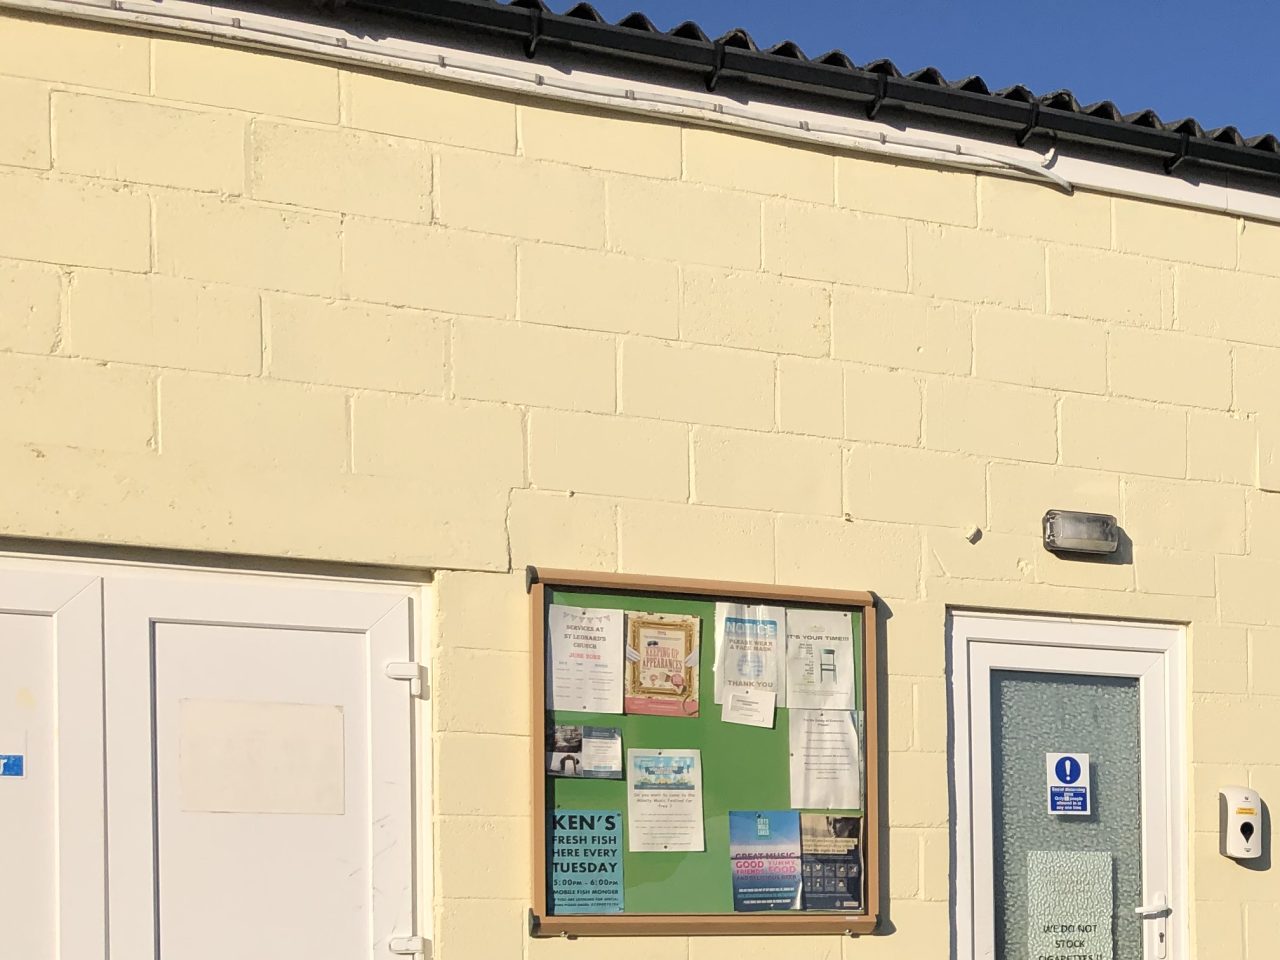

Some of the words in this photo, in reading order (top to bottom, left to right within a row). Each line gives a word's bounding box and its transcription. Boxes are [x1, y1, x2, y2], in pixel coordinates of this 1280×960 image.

[726, 622, 776, 635] NOTICE
[645, 647, 670, 658] KEEPING
[672, 648, 680, 659] UP
[642, 658, 682, 671] APPEARANCES
[757, 680, 774, 688] YOU
[552, 815, 616, 830] KEN'S
[552, 836, 588, 844] FRESH
[591, 836, 617, 844] FISH
[552, 848, 580, 857] HERE
[584, 848, 618, 857] EVERY
[552, 862, 618, 873] TUESDAY
[736, 860, 764, 868] GOOD
[768, 866, 796, 874] FOOD
[1043, 924, 1059, 933] WE
[1060, 924, 1075, 933] DO
[1078, 924, 1098, 932] NOT
[1056, 940, 1085, 948] STOCK
